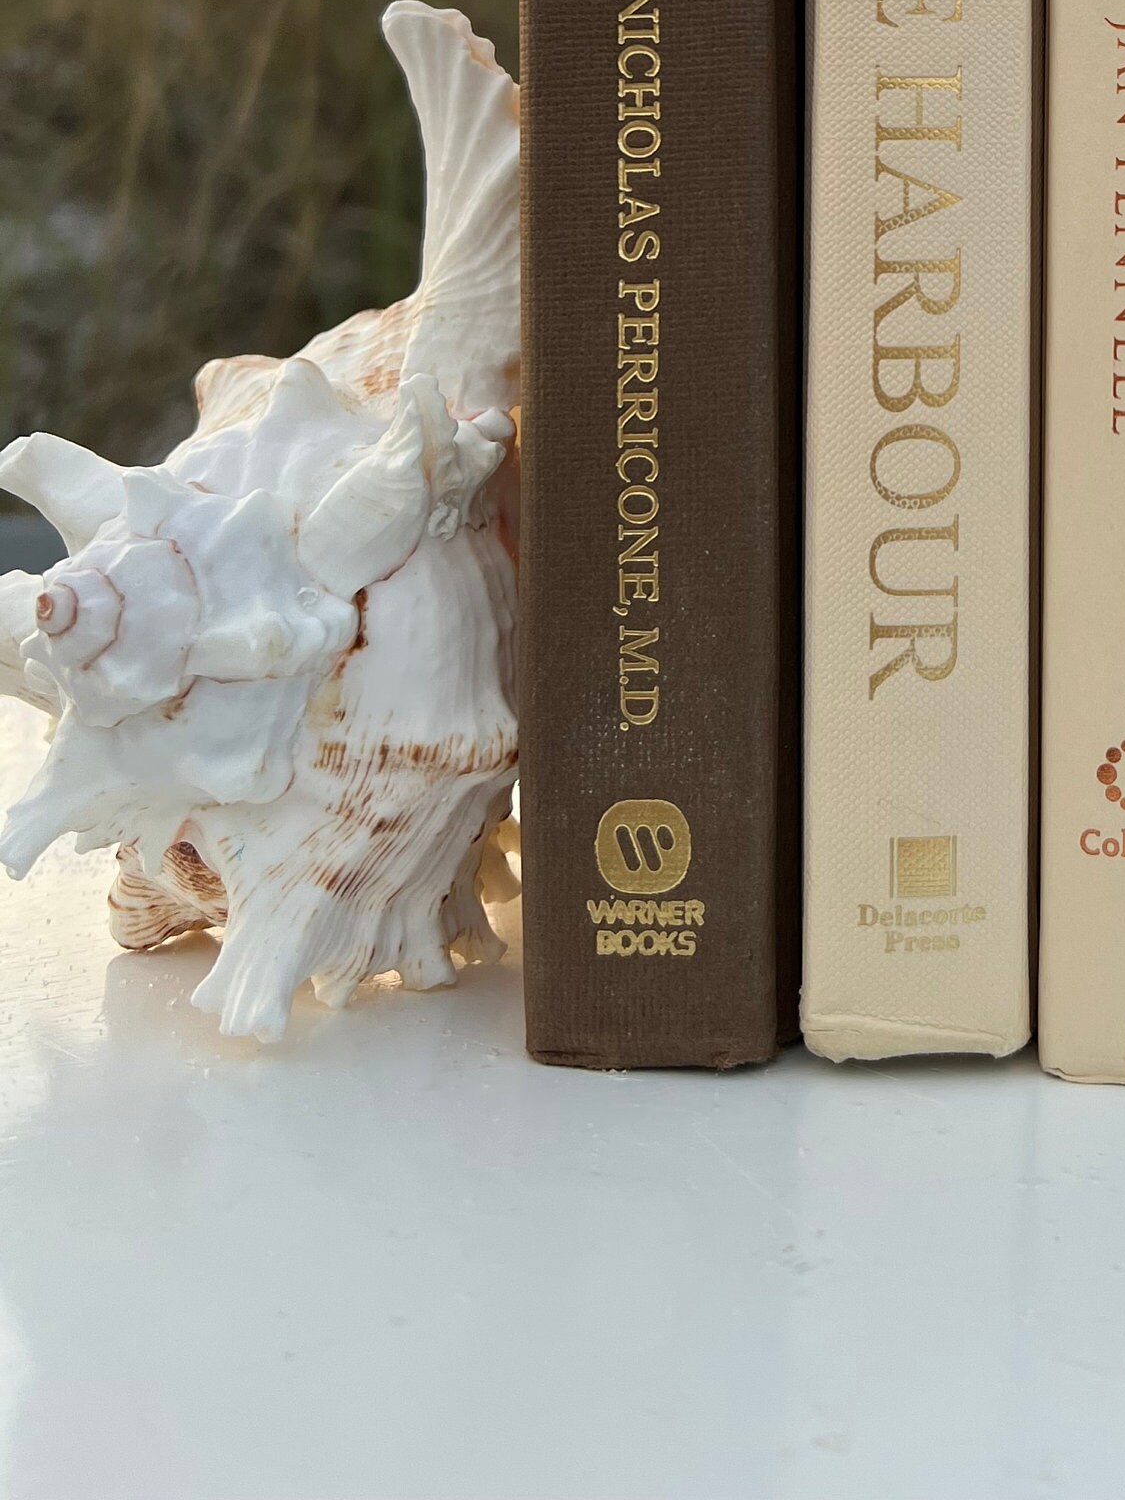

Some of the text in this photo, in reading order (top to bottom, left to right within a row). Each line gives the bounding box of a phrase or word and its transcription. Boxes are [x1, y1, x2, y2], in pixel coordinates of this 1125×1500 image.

[868, 63, 964, 701] HARBOUR
[612, 279, 661, 617] PERRICONE,
[617, 625, 660, 732] M.D.
[586, 898, 704, 927] WARNER
[857, 901, 987, 927] Delacorte
[595, 930, 697, 957] BOOKS
[883, 930, 961, 953] Press
